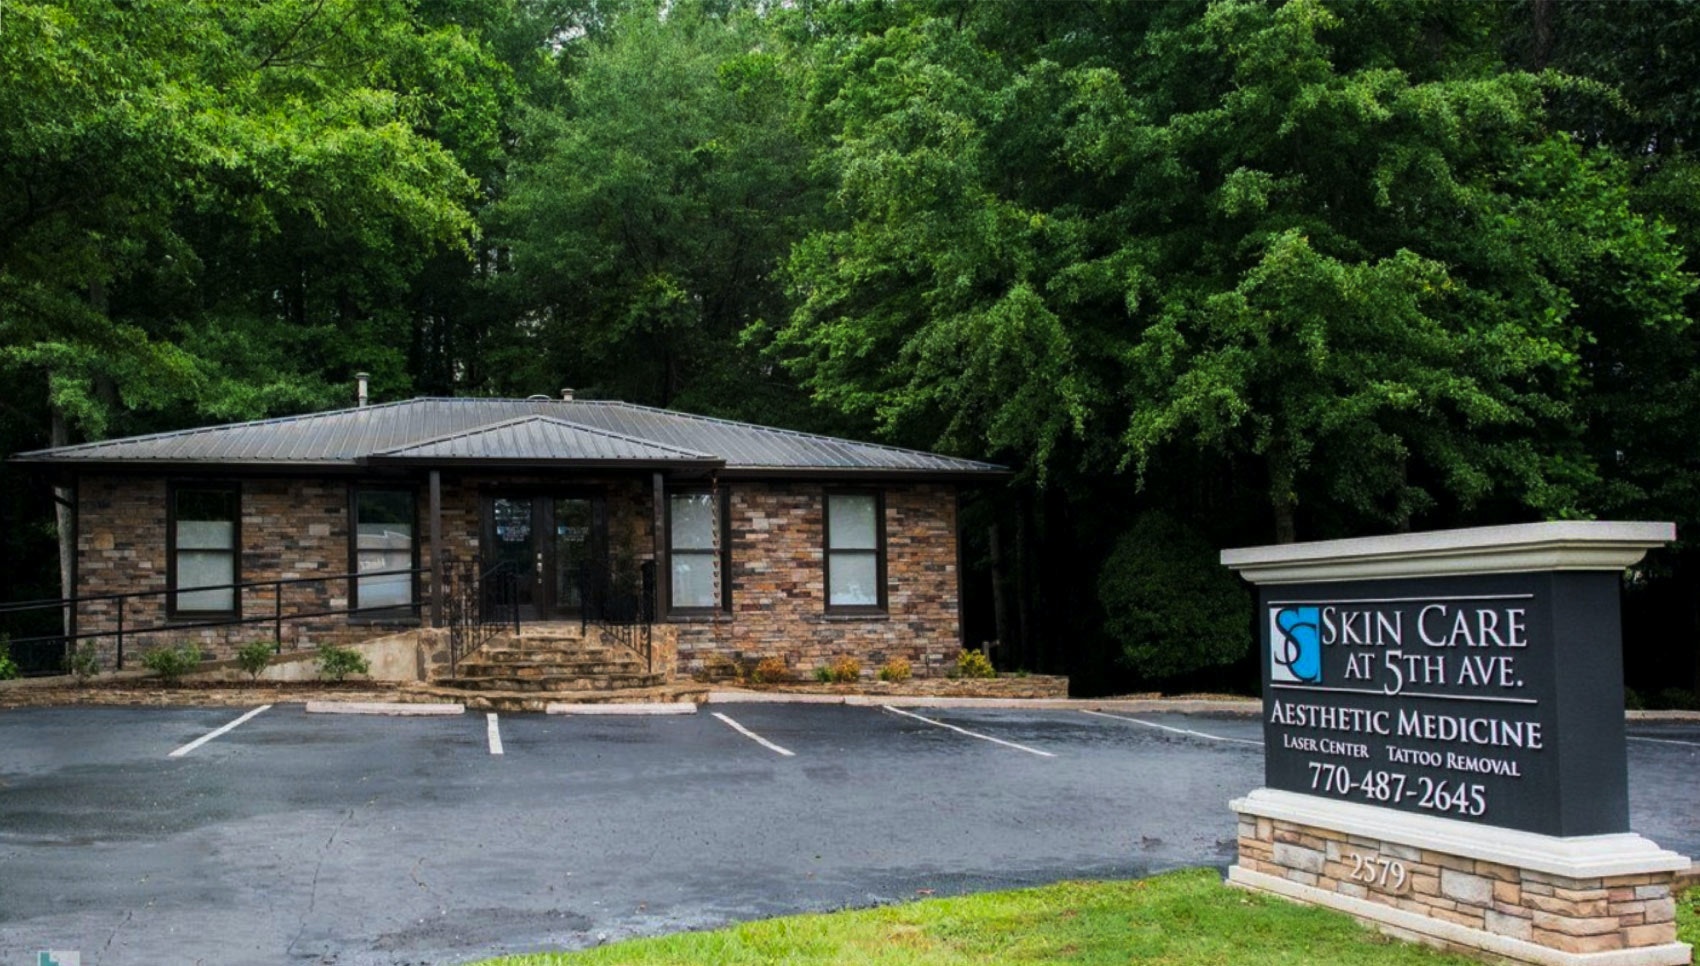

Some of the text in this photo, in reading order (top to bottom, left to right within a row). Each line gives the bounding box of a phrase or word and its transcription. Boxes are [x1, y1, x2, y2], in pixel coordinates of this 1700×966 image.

[1322, 604, 1527, 647] SKIN CARE
[1344, 650, 1524, 694] AT 5TH AVE.
[1270, 700, 1543, 749] AESTHETIC MEDICINE
[1283, 734, 1370, 758] LASER CENTER
[1386, 745, 1521, 777] TATTOO REMOVAL
[1308, 762, 1486, 816] 770-487-2645
[1350, 853, 1405, 888] 2579
